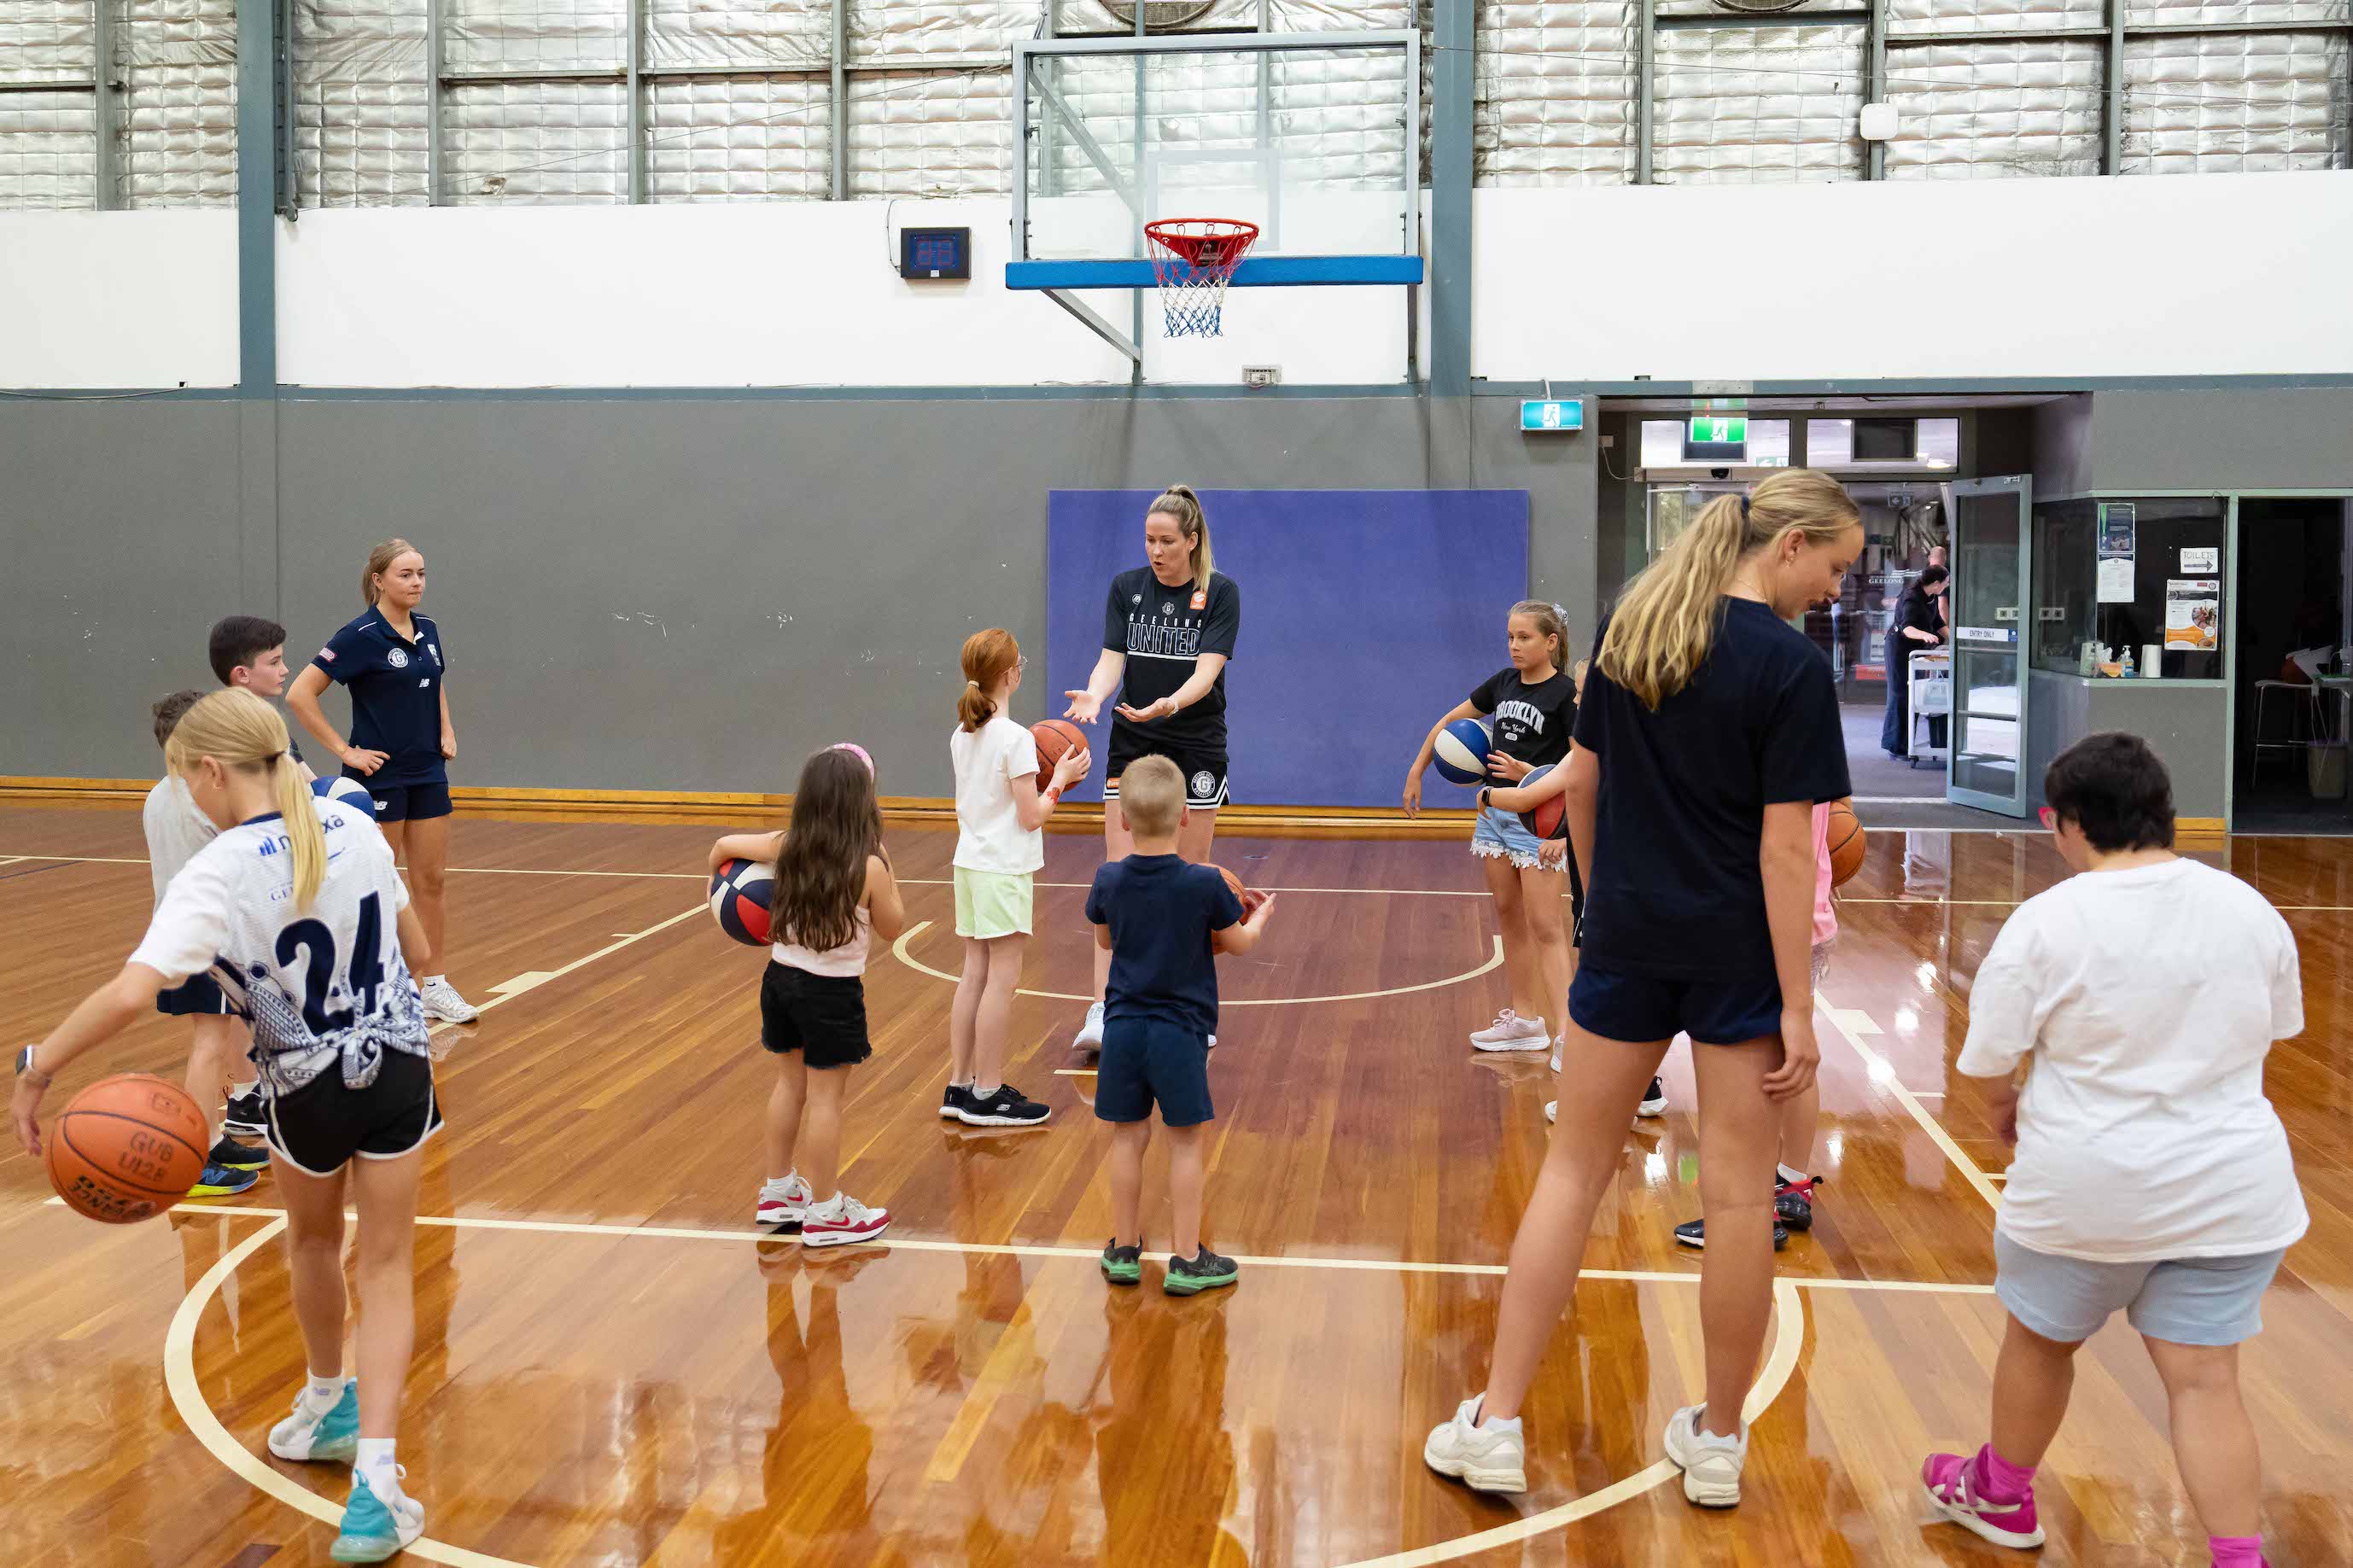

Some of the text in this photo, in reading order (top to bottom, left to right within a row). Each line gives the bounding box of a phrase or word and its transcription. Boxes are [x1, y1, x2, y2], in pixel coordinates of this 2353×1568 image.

[2183, 551, 2214, 559] TOILETS
[1130, 613, 1202, 628] GEELONG
[1127, 622, 1200, 656] UNITED
[275, 890, 384, 1037] 24
